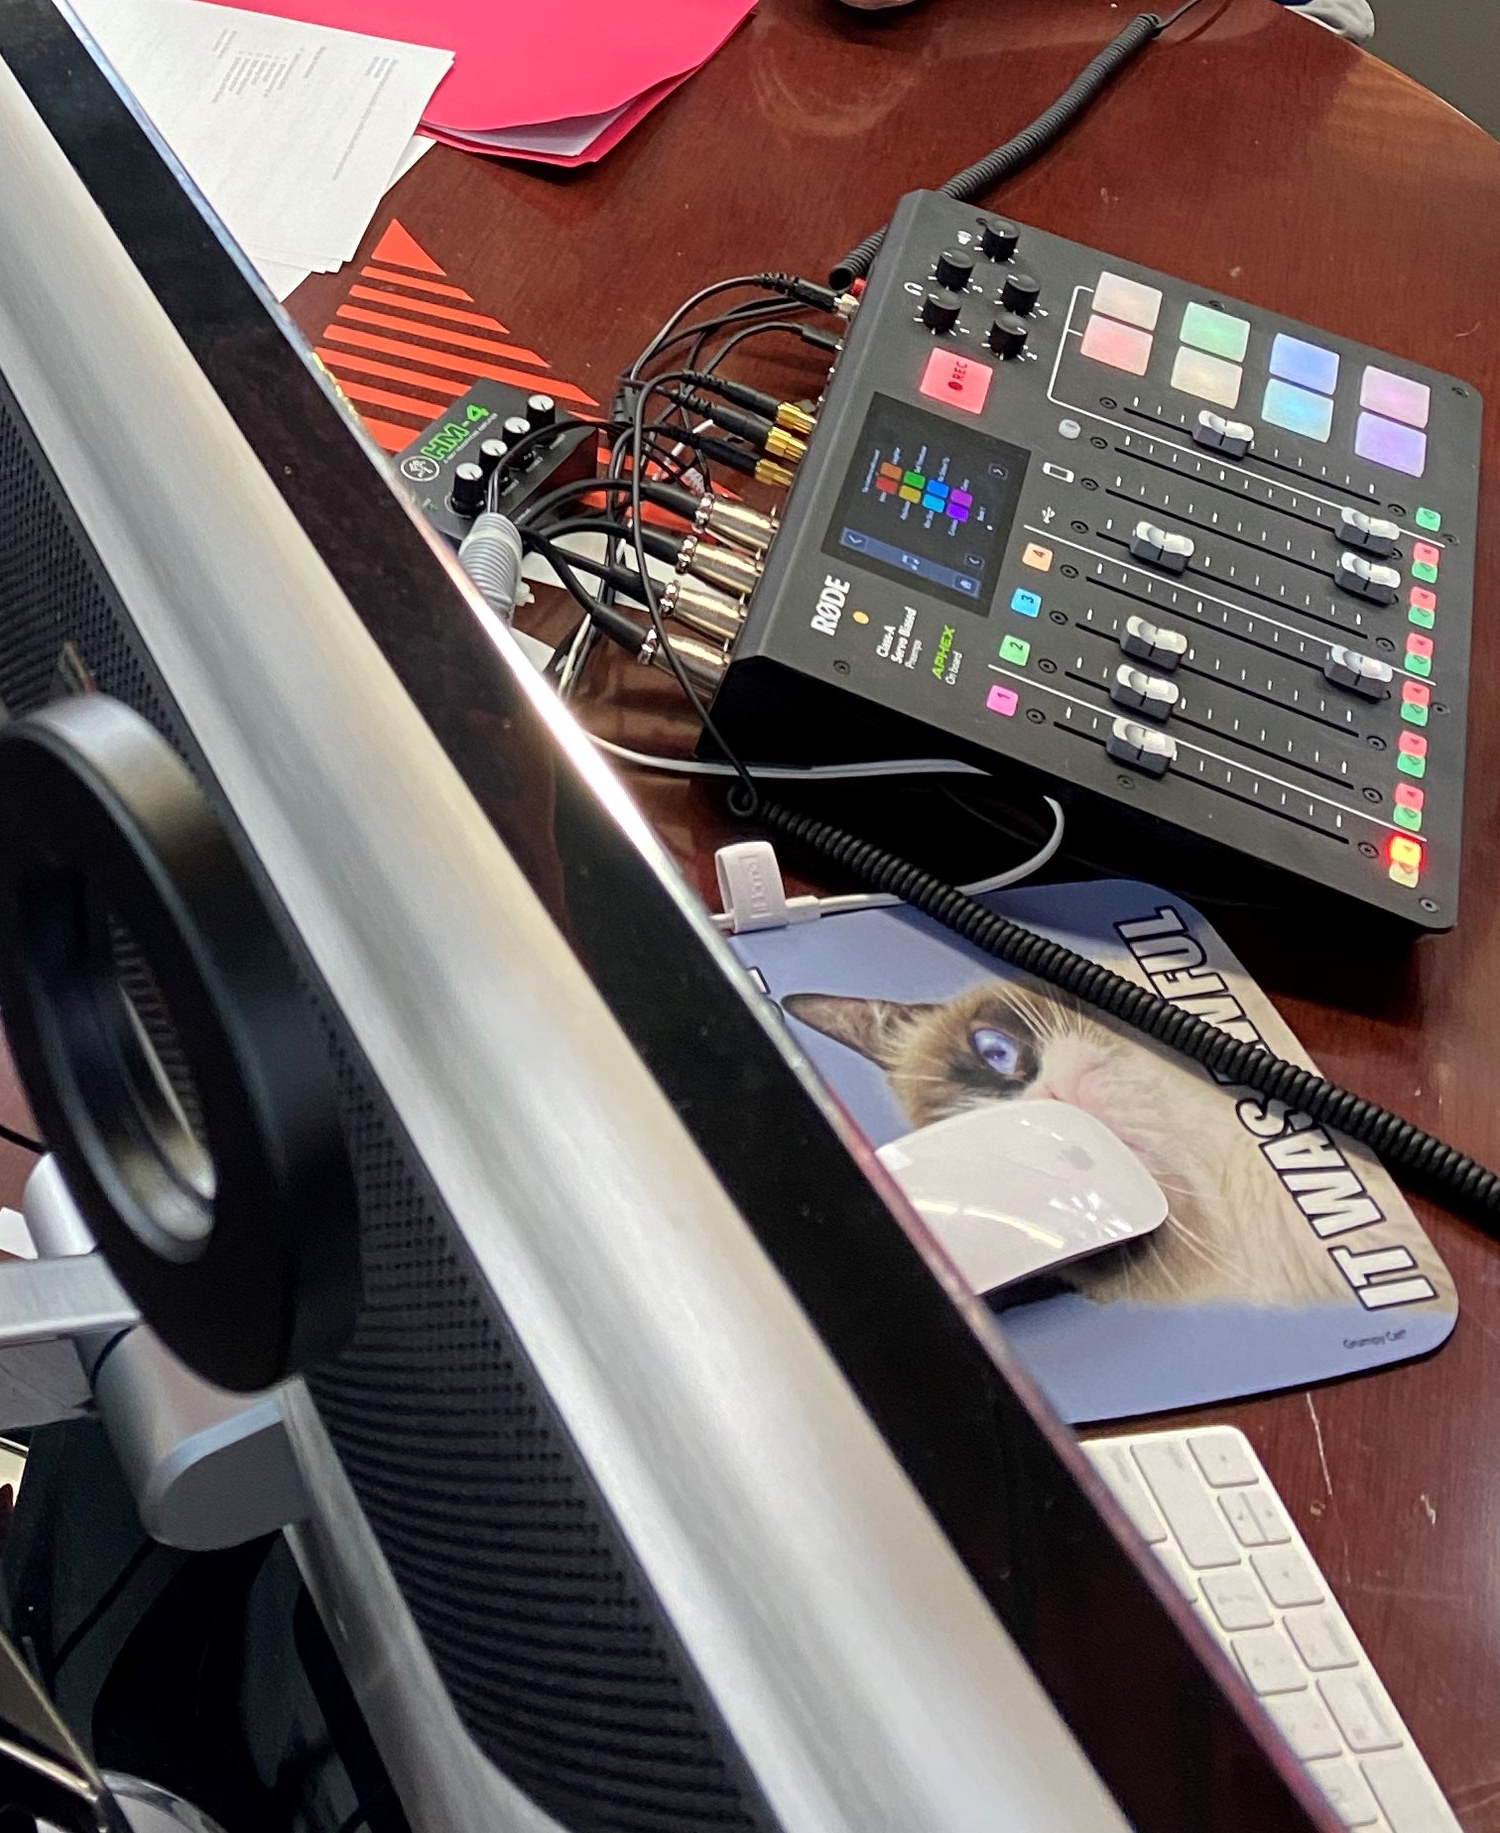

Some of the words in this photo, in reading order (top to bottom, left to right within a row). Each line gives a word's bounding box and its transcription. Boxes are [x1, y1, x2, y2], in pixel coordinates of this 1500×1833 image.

[952, 361, 968, 381] REC
[420, 405, 489, 460] HM-4
[1021, 594, 1034, 605] 3
[932, 625, 956, 679] APHEX
[1009, 640, 1024, 651] 2
[1113, 905, 1279, 1086] WFUL
[1236, 1096, 1387, 1240] WAS
[1327, 1245, 1440, 1311] IT
